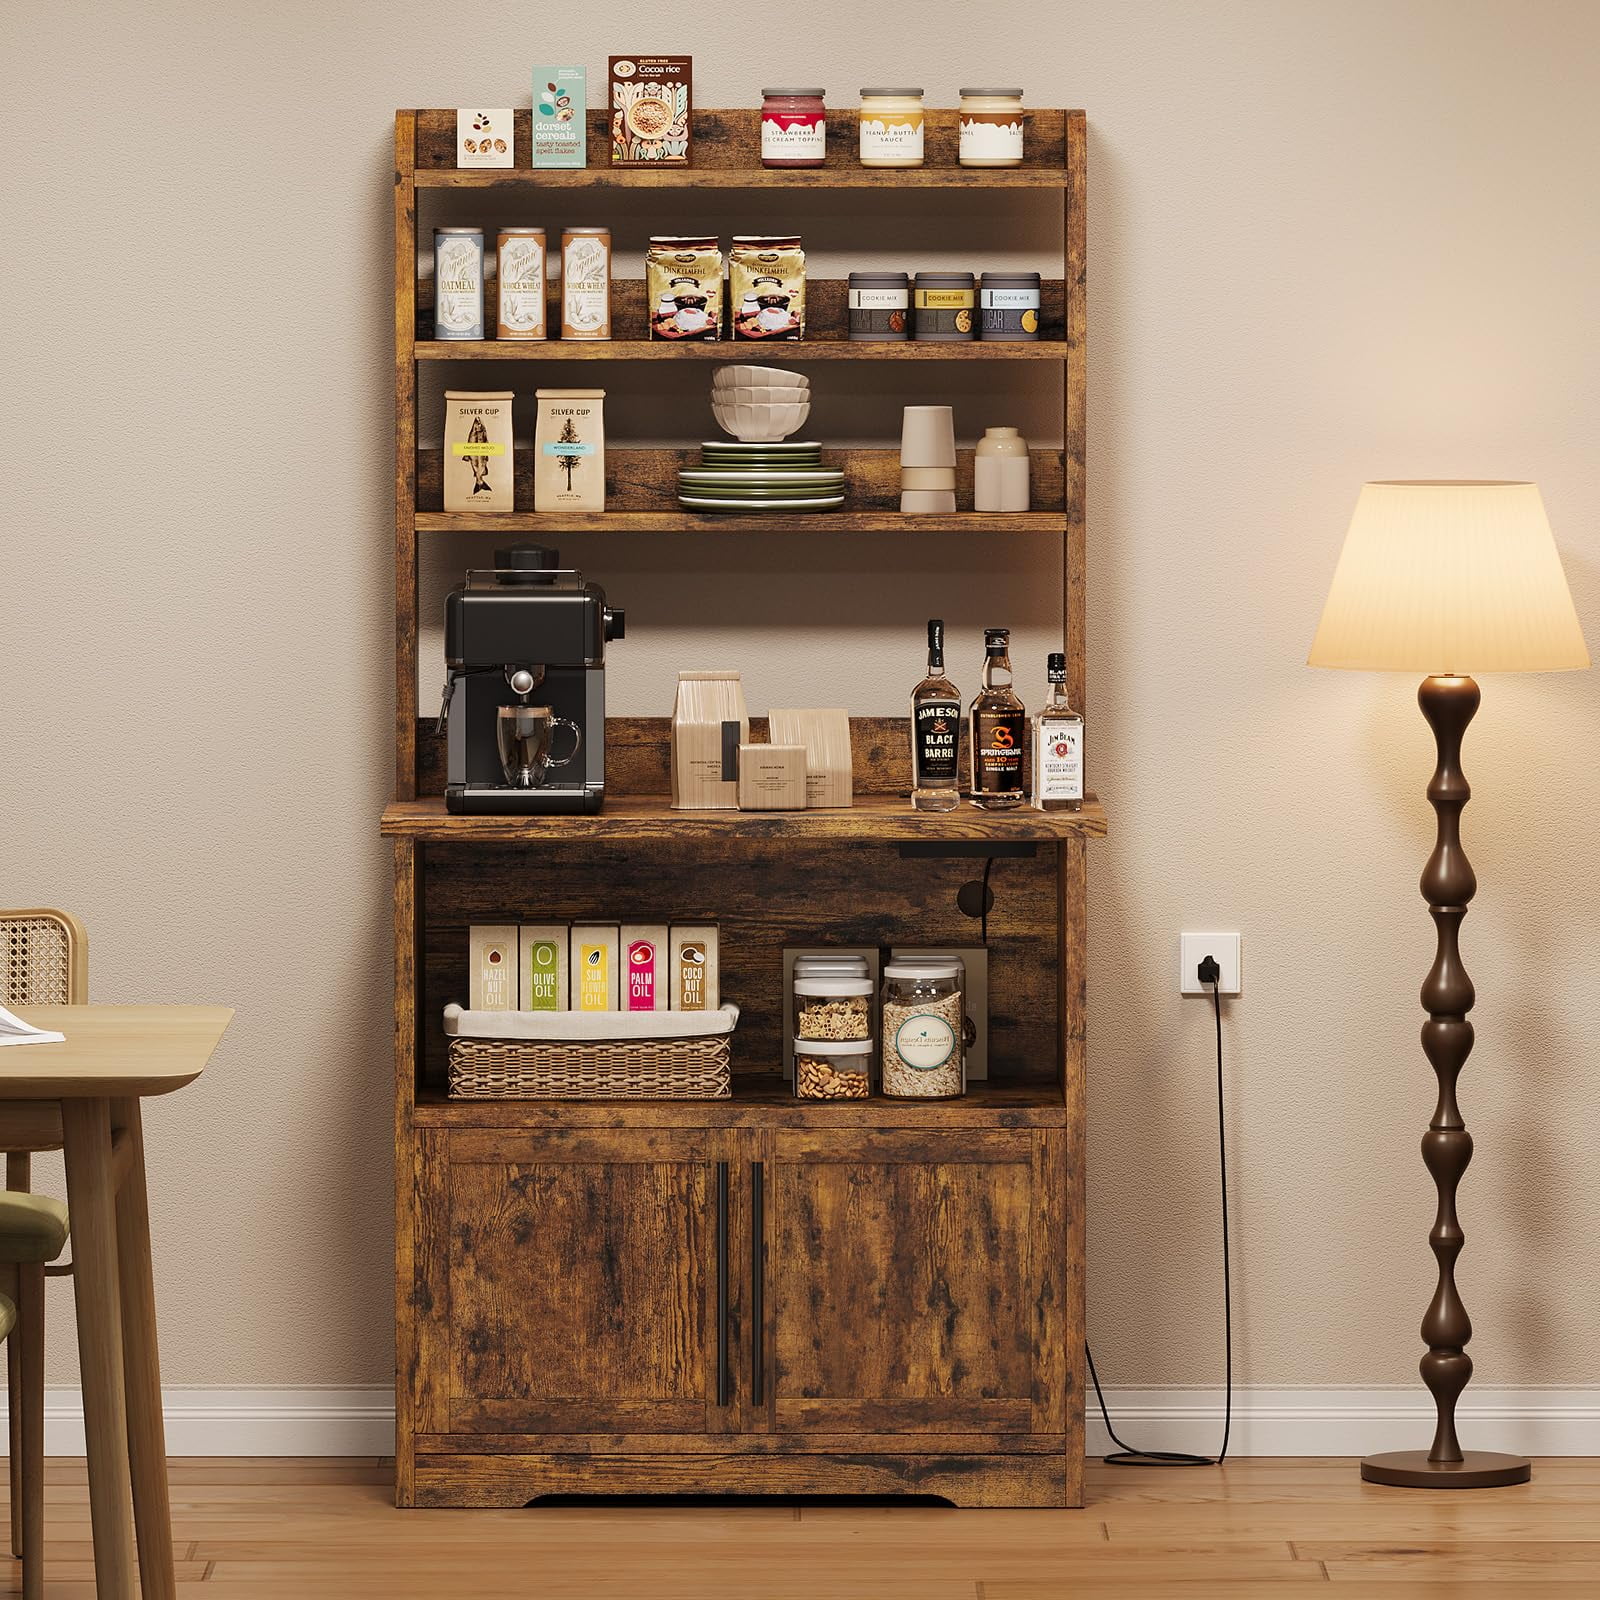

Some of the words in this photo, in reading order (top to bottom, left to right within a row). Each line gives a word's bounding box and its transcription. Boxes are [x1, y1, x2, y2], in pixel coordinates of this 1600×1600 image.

[638, 65, 664, 73] Cocoa
[666, 65, 680, 73] rice
[536, 122, 572, 130] dorset
[536, 131, 576, 140] cereals
[664, 266, 706, 274] DINKELMEHL
[746, 266, 789, 274] DINKELMEHL
[442, 281, 476, 290] OATMEAL
[919, 707, 958, 720] JAMESON
[926, 735, 953, 745] BLACK
[1048, 735, 1058, 746] JIM
[1060, 732, 1075, 744] BEAM
[925, 748, 954, 758] BARREL
[484, 968, 506, 980] HAZEL
[534, 973, 555, 985] OLIVE
[586, 969, 601, 980] SUN
[631, 973, 652, 984] PALM
[683, 968, 702, 980] COCO
[488, 981, 502, 992] NUT
[536, 985, 553, 997] OIL
[633, 985, 651, 997] OIL
[686, 980, 700, 991] NUT
[487, 993, 504, 1005] OIL
[586, 994, 602, 1005] OIL
[684, 992, 702, 1003] OIL
